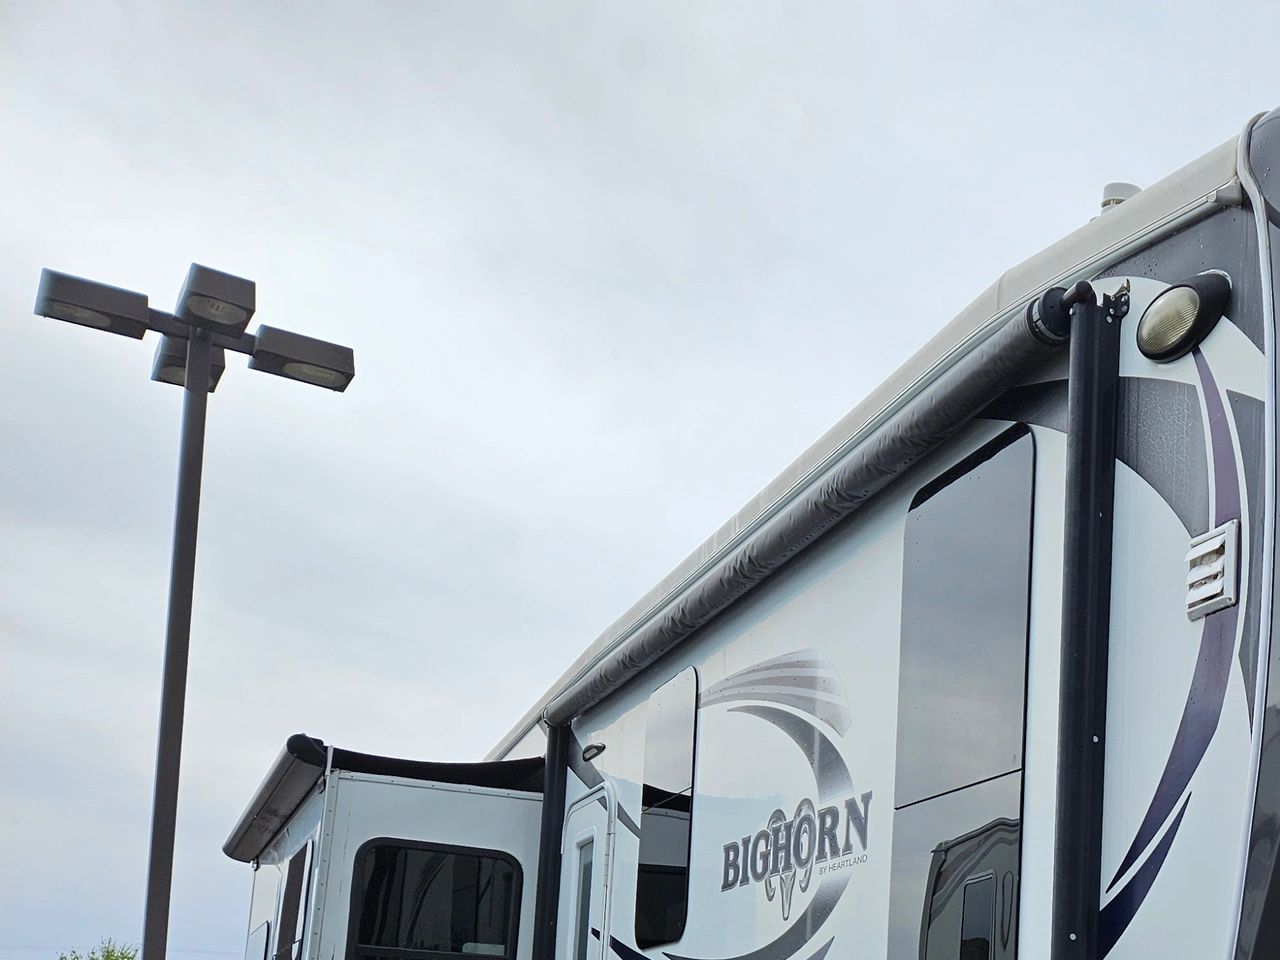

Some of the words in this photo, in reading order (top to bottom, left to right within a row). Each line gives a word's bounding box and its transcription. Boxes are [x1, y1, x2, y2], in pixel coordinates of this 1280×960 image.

[721, 790, 873, 892] BIGHORN
[819, 864, 828, 875] BY
[828, 854, 868, 872] HEARTLAND
